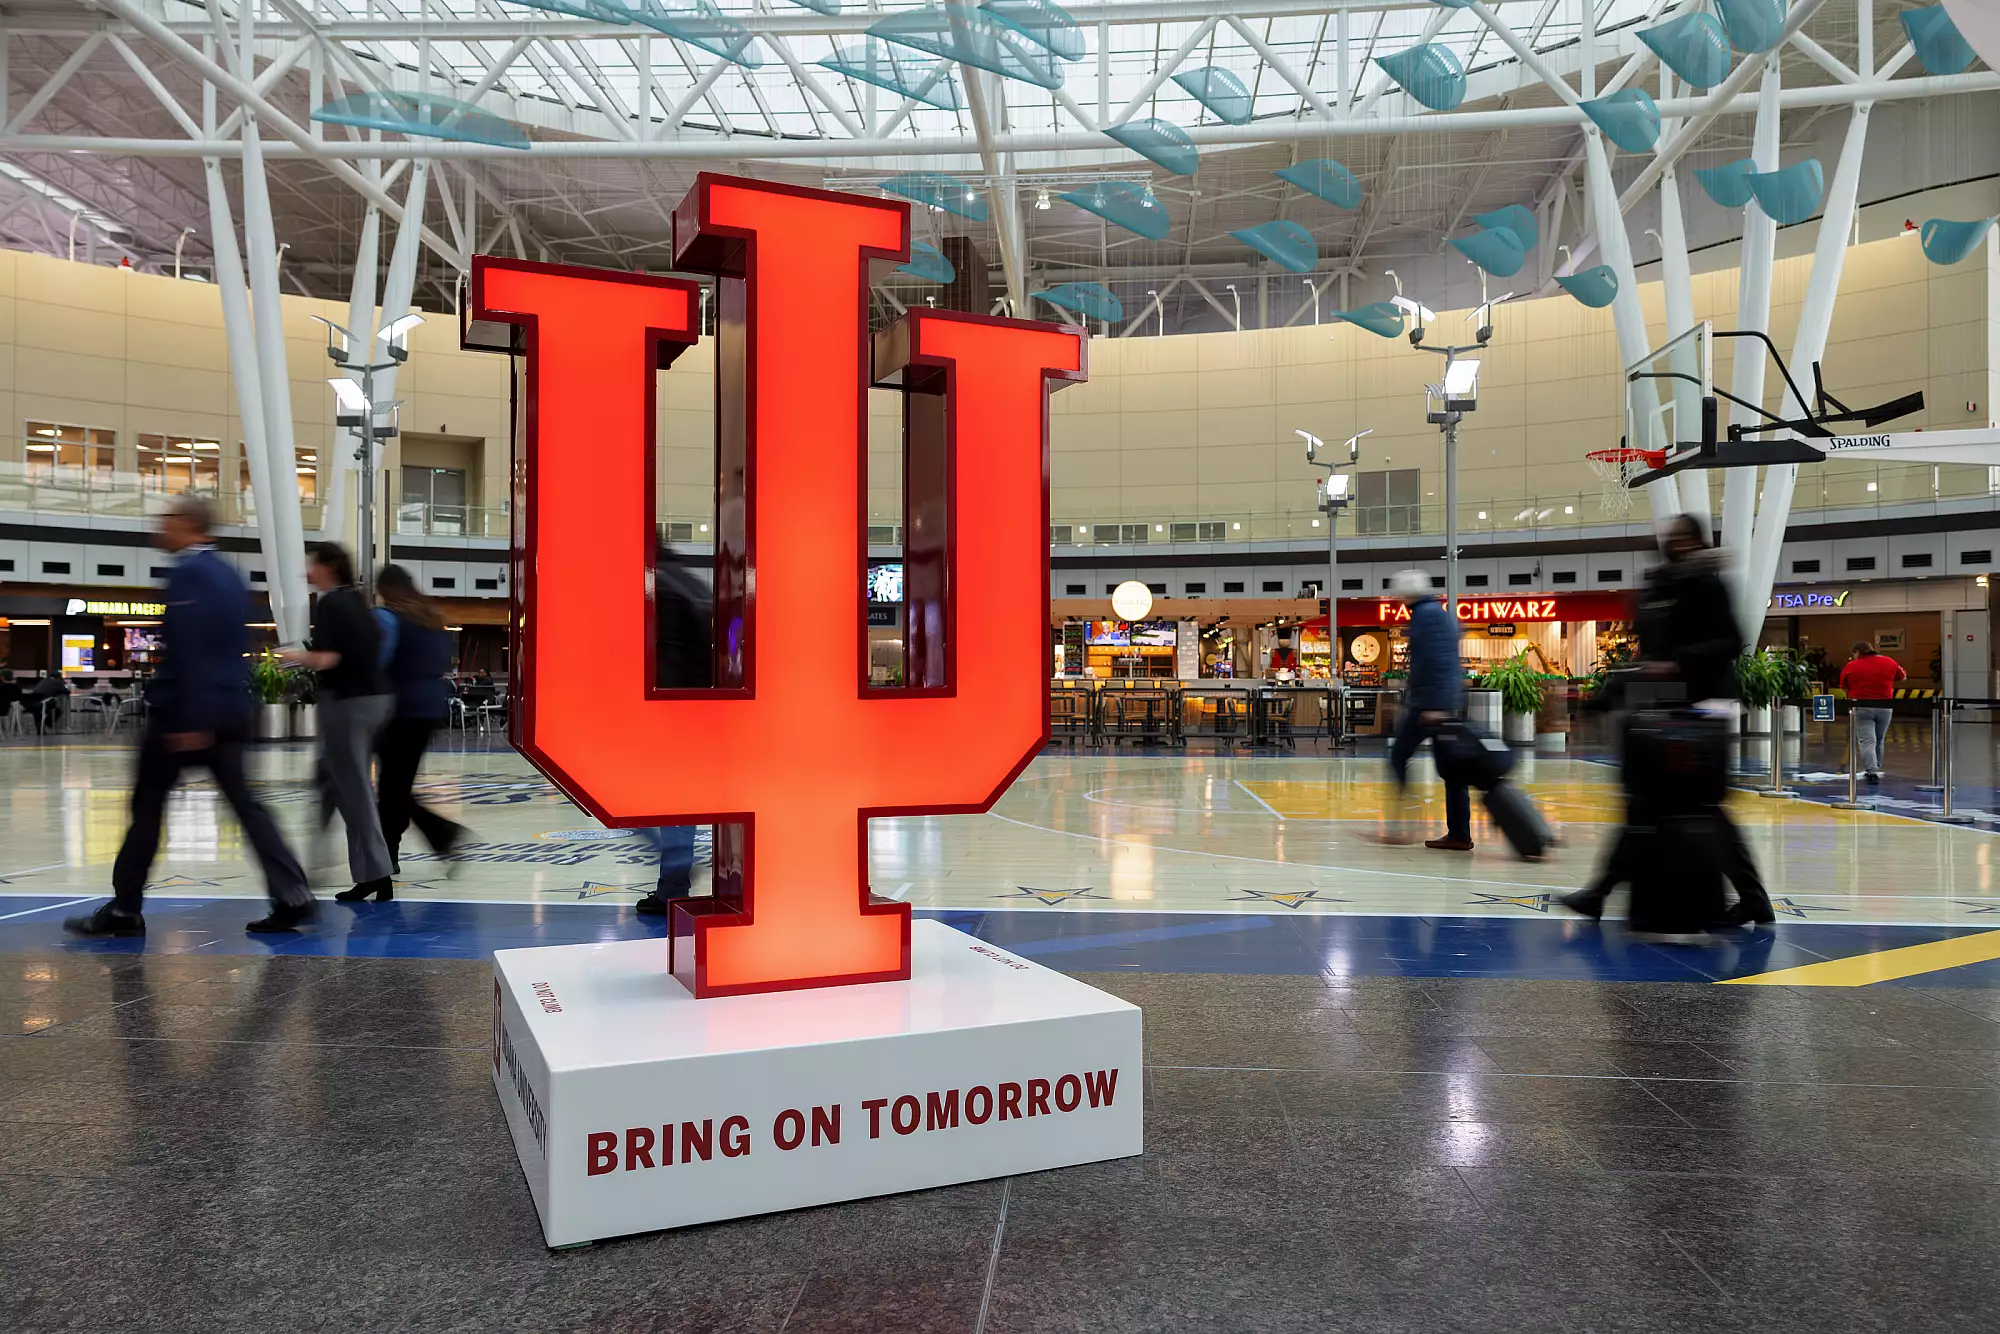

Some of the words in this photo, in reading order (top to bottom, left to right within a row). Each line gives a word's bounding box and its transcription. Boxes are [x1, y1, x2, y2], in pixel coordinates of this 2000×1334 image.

[1829, 434, 1890, 450] SPALDING
[87, 601, 129, 614] INDIANA
[1776, 594, 1804, 607] TSA
[586, 1114, 751, 1177] BRING
[772, 1104, 841, 1152] ON
[861, 1068, 1119, 1140] TOMORROW
